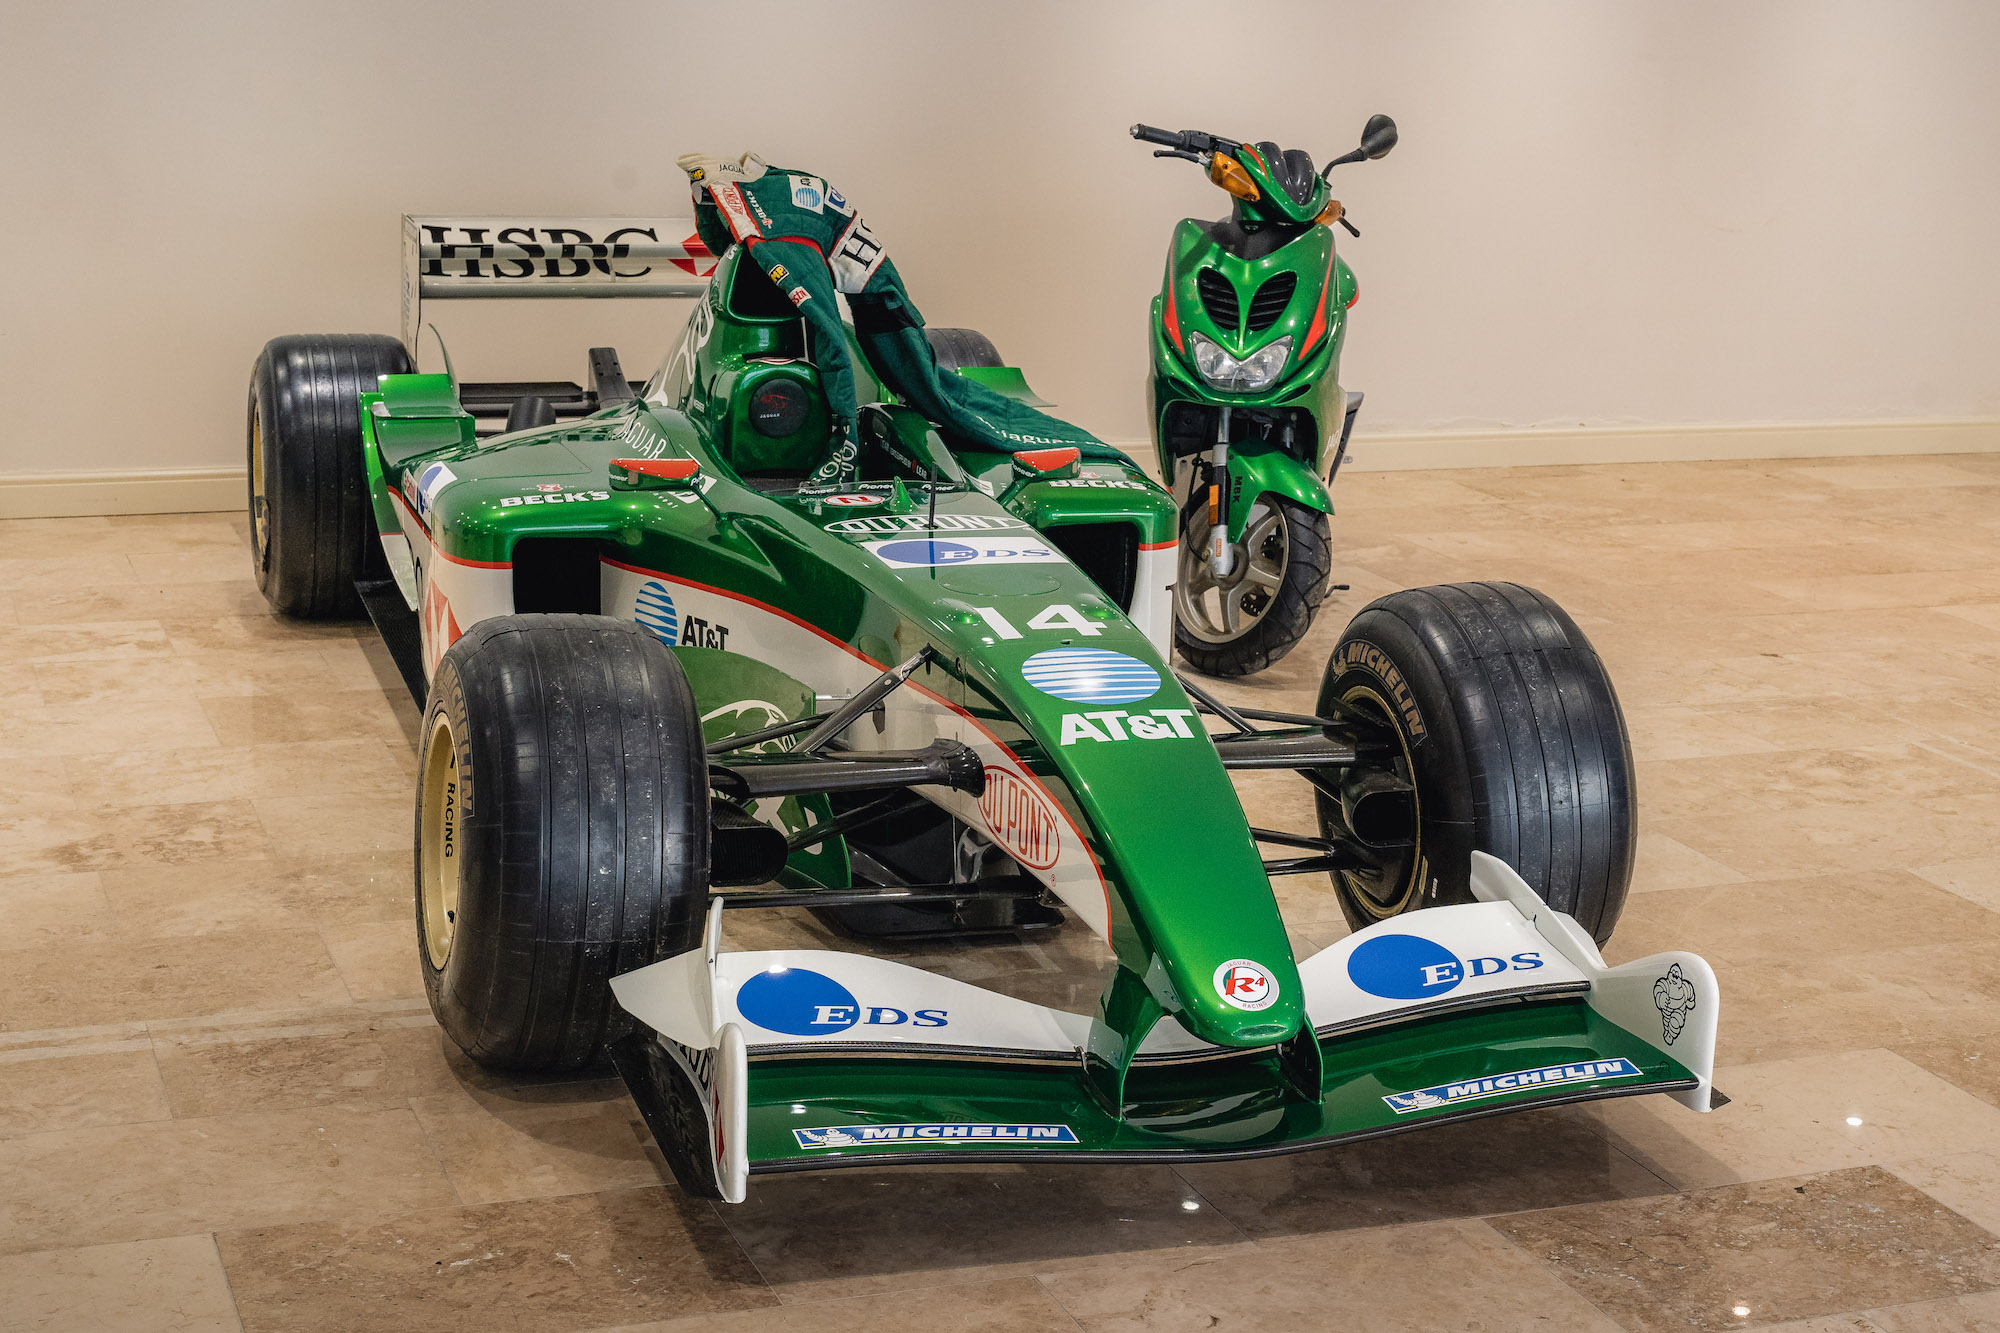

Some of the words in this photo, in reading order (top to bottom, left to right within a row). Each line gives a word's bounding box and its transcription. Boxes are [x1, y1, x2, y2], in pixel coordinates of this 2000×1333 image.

[421, 224, 660, 279] HSBC
[500, 490, 610, 507] BECK'S
[798, 487, 837, 495] Pioneer
[1232, 476, 1243, 504] MBK
[940, 549, 1051, 560] EDS
[681, 614, 730, 650] AT&T
[974, 604, 1108, 640] 14
[1346, 642, 1424, 736] MICHELIN
[1060, 709, 1195, 746] AT&T
[444, 781, 456, 858] RACING
[1226, 961, 1252, 969] JAGUAR
[1421, 951, 1544, 987] EDS
[810, 1004, 949, 1028] EDS
[1242, 1001, 1268, 1010] RACING
[1446, 1059, 1624, 1097] MICHELIN
[862, 1125, 1060, 1139] MICHELIN
